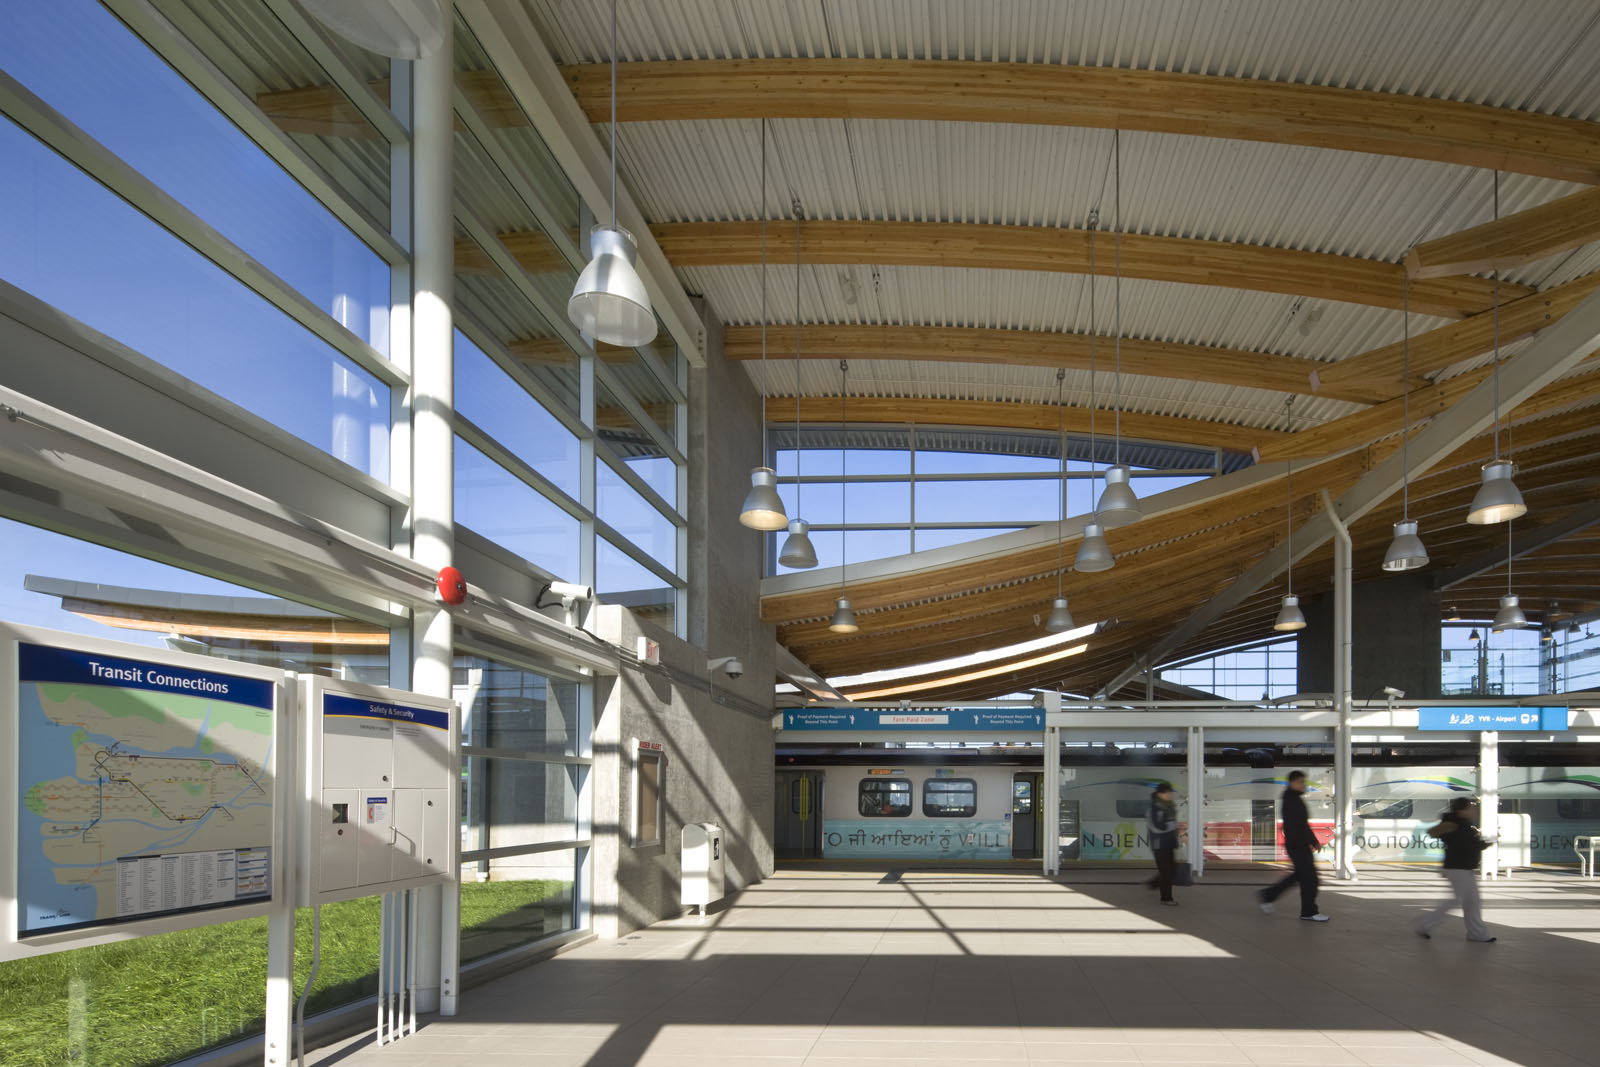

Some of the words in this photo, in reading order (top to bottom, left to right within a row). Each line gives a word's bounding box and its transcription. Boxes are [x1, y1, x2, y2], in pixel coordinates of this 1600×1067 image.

[88, 661, 143, 683] Transit
[146, 670, 229, 694] Connections
[369, 704, 387, 716] Safety
[393, 709, 415, 719] Security
[1495, 715, 1517, 723] Airport
